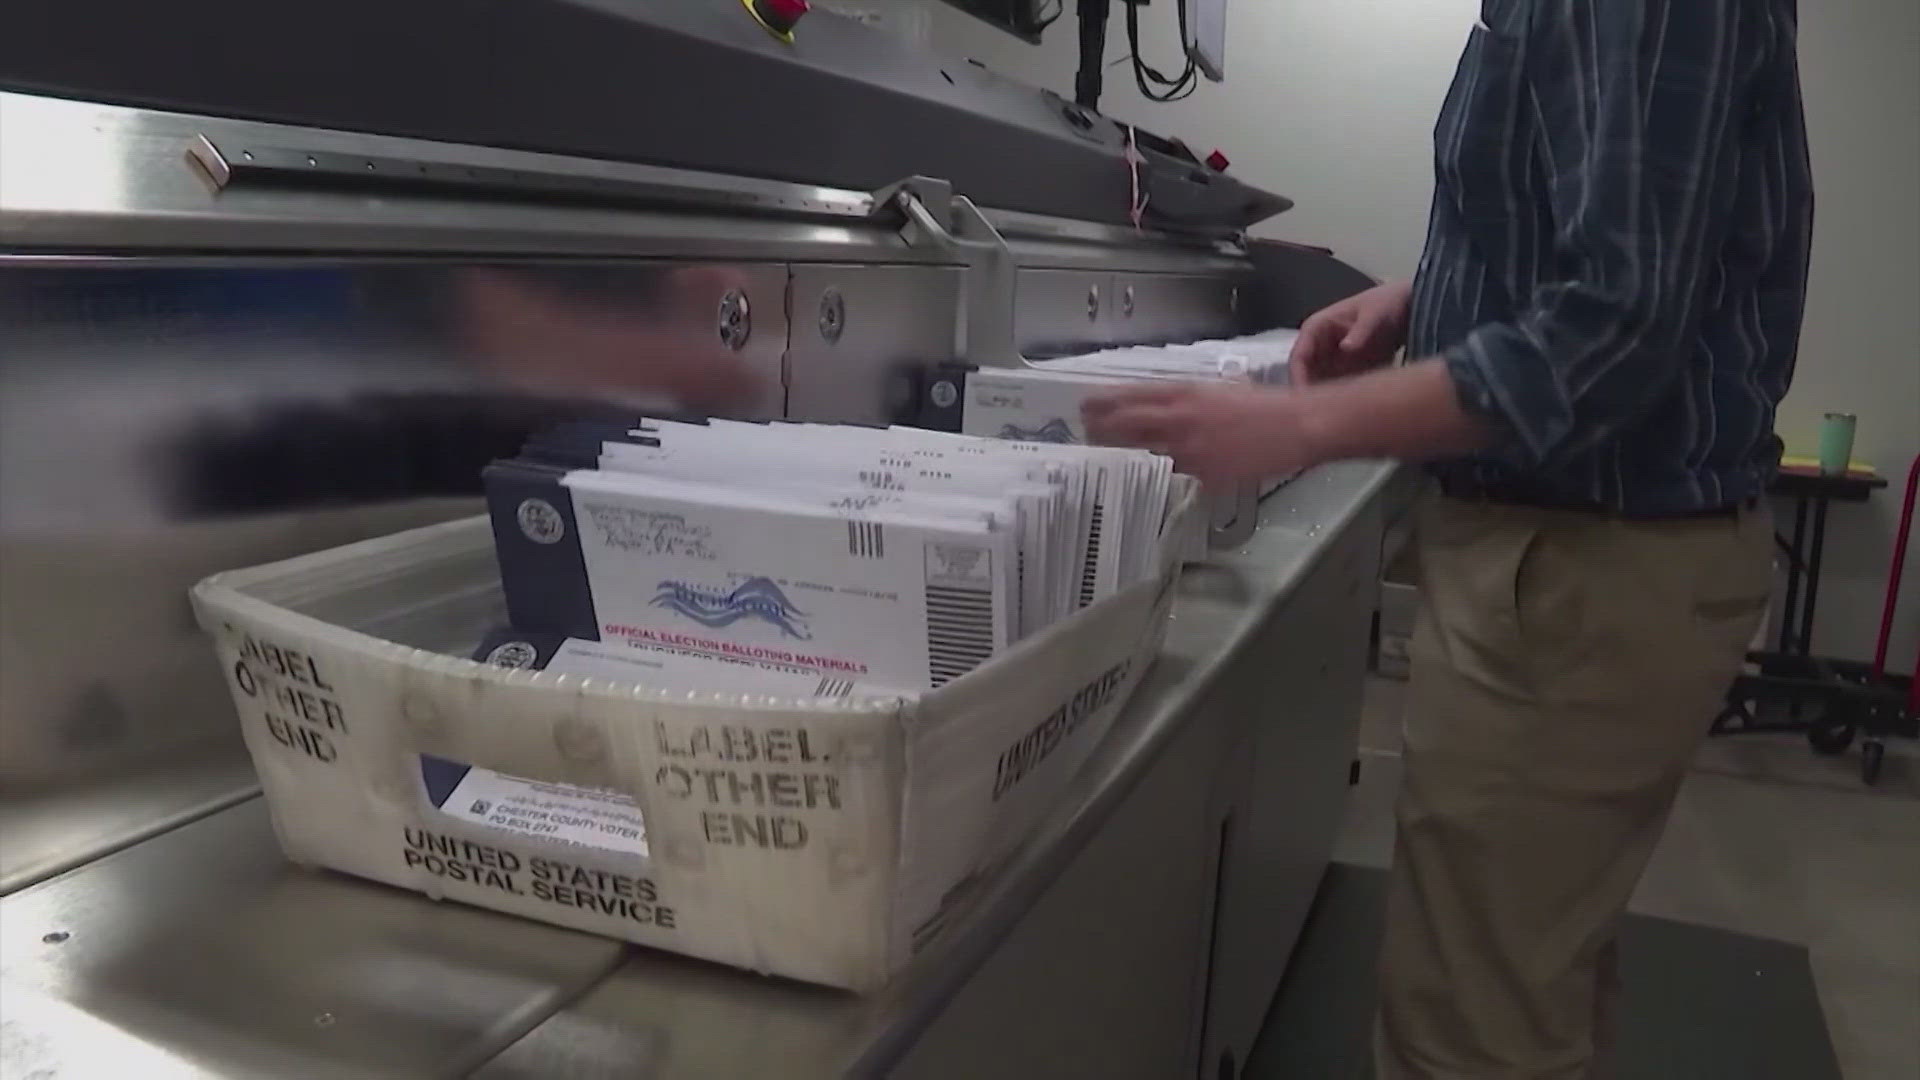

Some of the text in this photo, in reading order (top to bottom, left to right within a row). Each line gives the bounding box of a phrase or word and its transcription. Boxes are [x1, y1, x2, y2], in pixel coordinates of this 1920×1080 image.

[239, 632, 333, 693] ABEL
[605, 623, 656, 641] OFFICIAL
[660, 632, 720, 652] ELECTION
[721, 643, 793, 663] BALLOTING
[795, 653, 868, 675] MATERIALS
[264, 711, 338, 763] END
[653, 715, 830, 763] LABEL
[655, 763, 842, 810] OTHER
[489, 814, 507, 825] PO
[507, 818, 530, 830] BOX
[496, 804, 550, 822] CHESTER
[550, 814, 598, 831] COUNTY
[599, 822, 641, 840] VOTER
[702, 811, 808, 851] END
[403, 827, 521, 874] UNITED
[530, 855, 659, 903] STATES
[403, 849, 677, 930] POSTAL SERVICE
